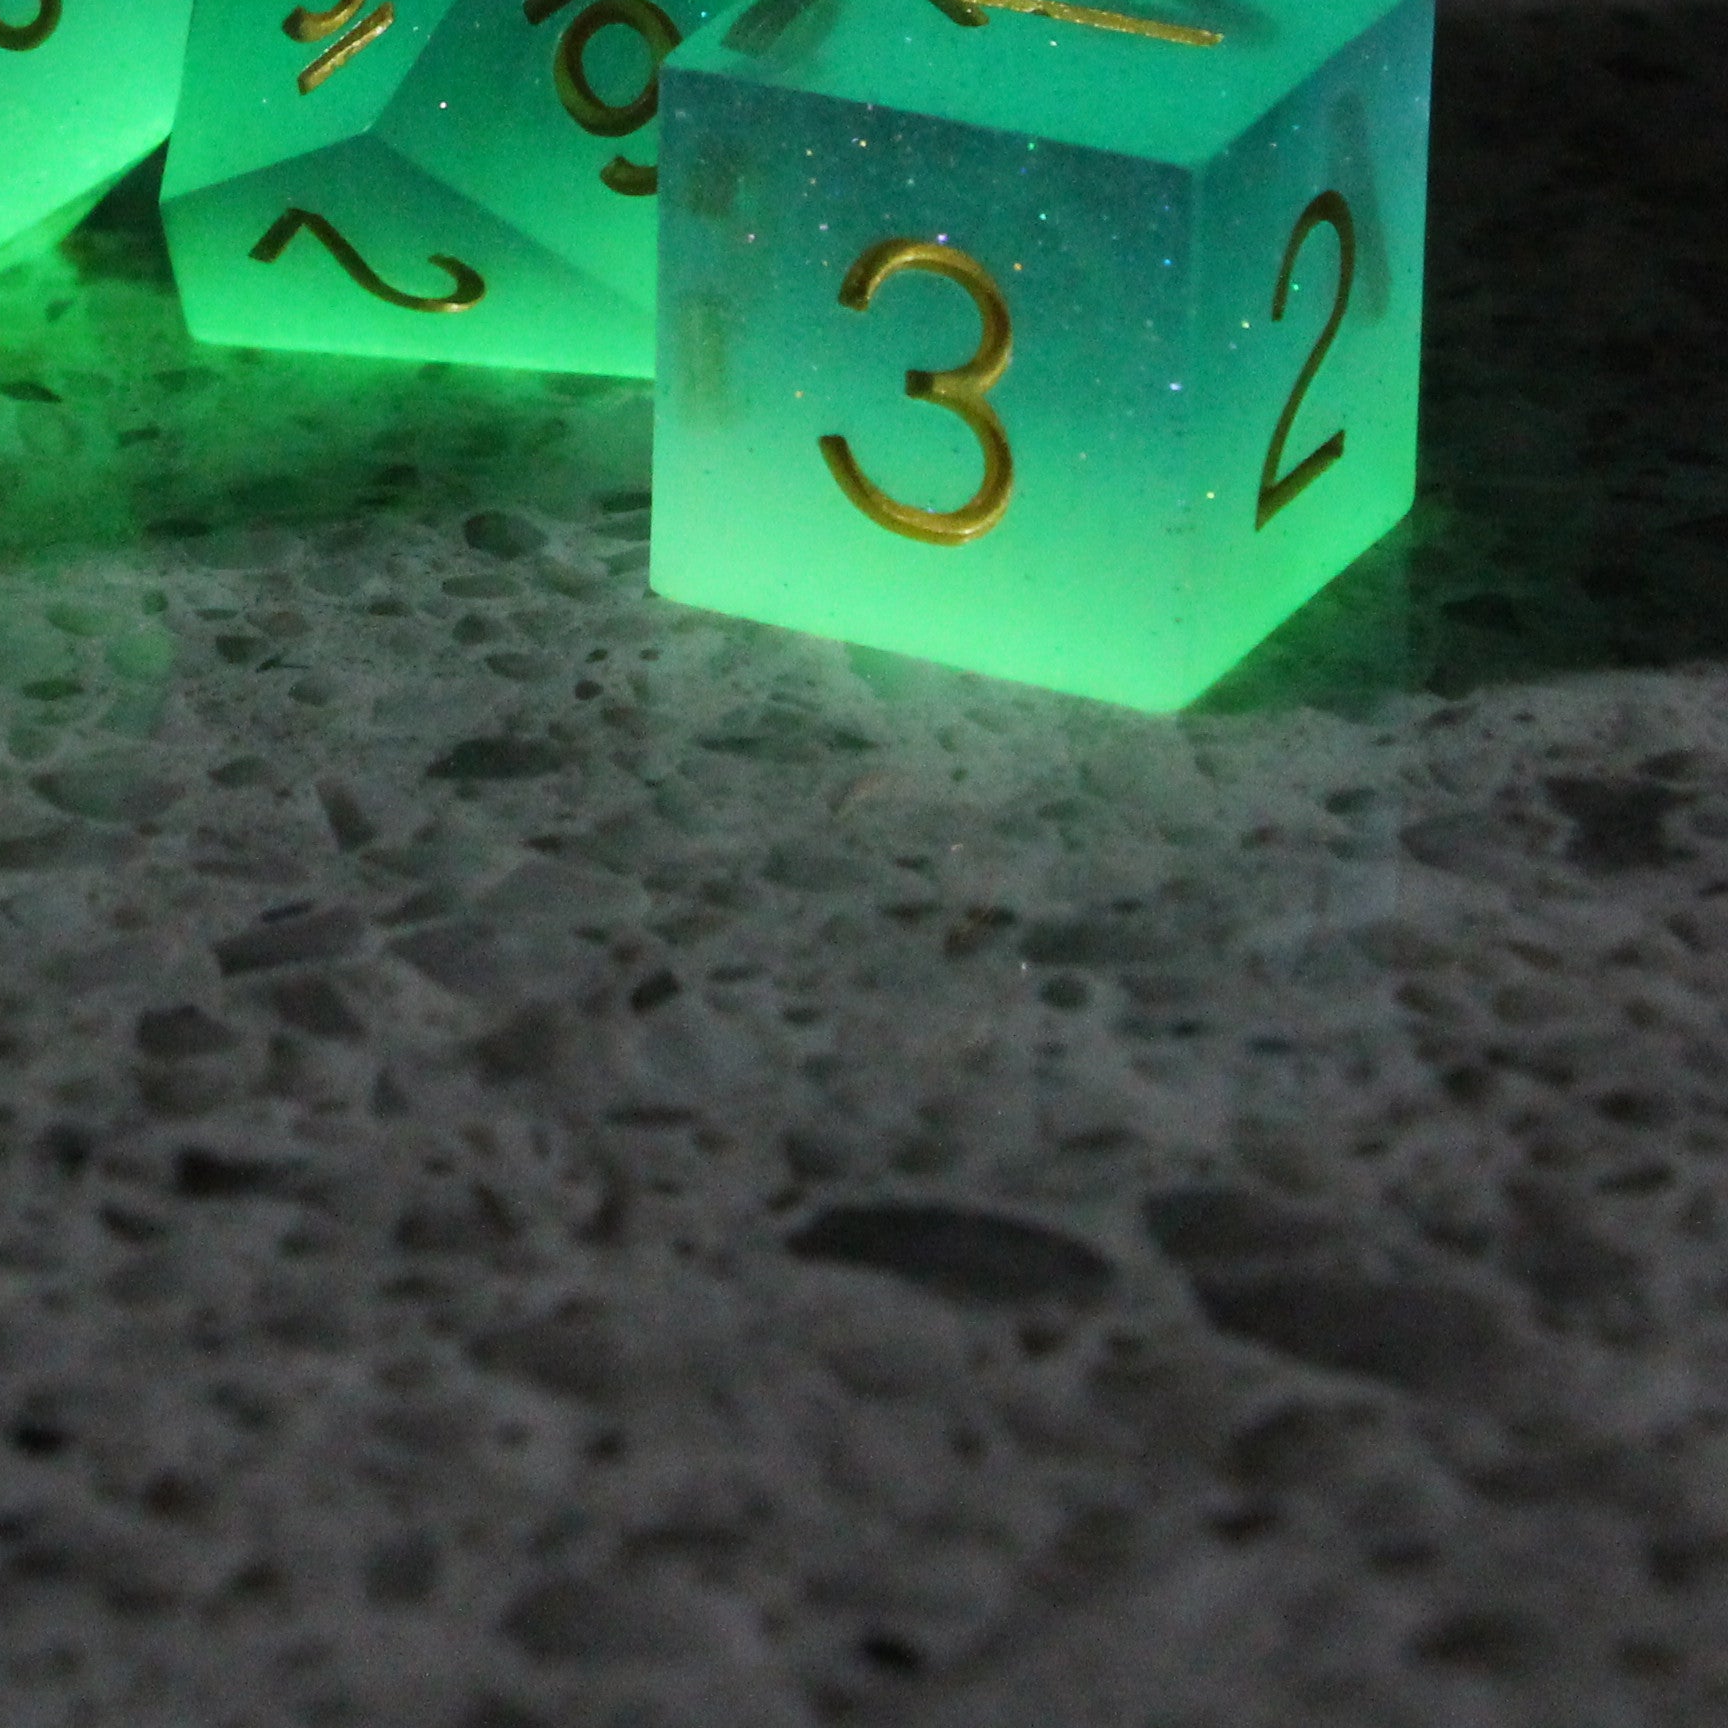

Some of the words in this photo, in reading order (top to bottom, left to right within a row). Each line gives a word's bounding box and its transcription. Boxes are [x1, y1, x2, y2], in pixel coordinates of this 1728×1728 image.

[248, 207, 487, 314] 2
[817, 236, 1015, 547] 3
[1255, 188, 1357, 533] 2
